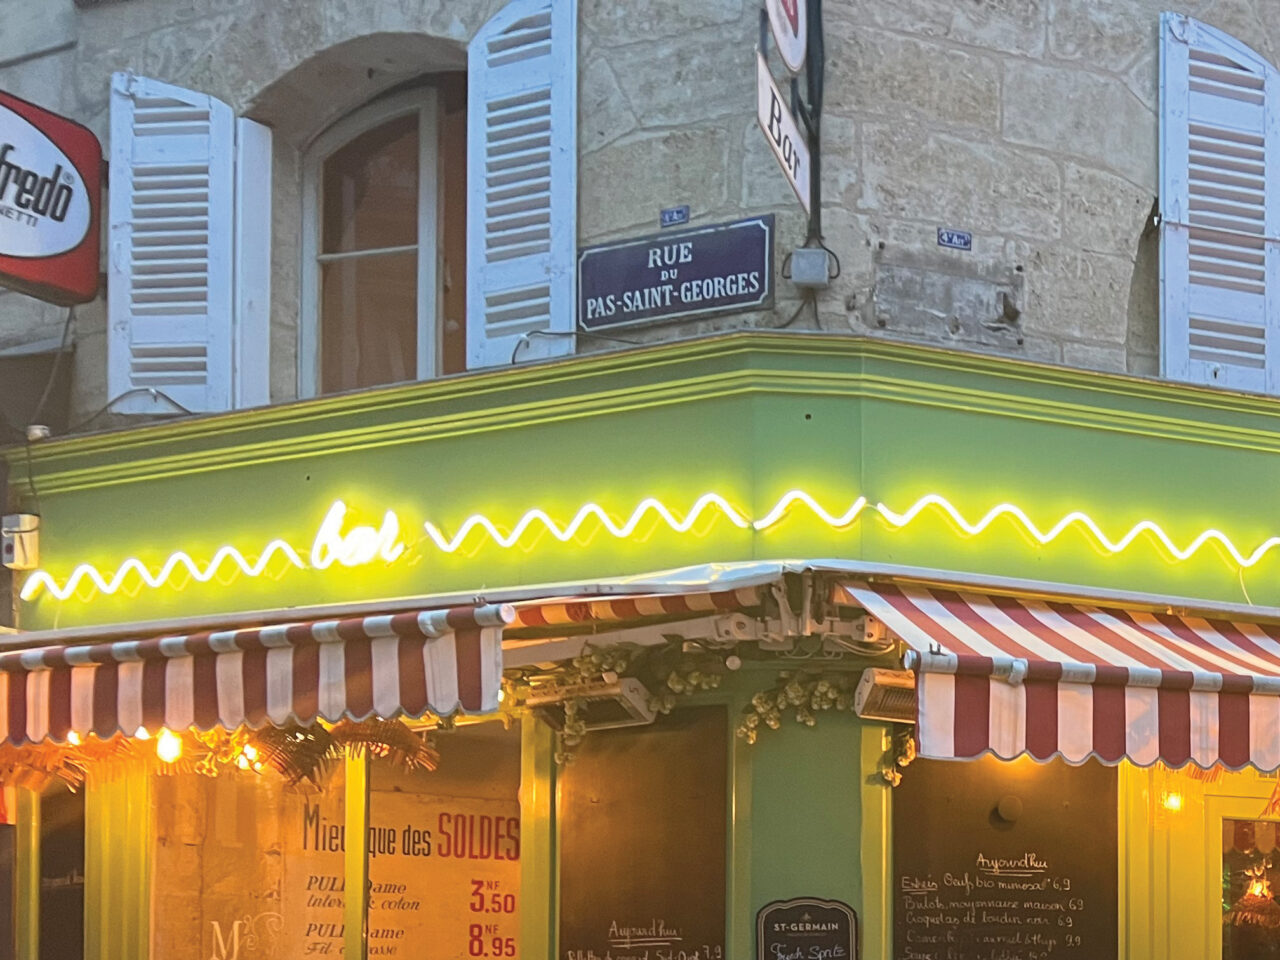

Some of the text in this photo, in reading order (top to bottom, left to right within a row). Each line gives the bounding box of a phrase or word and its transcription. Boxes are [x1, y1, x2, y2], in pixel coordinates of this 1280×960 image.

[766, 86, 801, 181] Bar
[648, 242, 693, 268] RUE
[660, 269, 678, 281] DU
[586, 271, 760, 320] PAS-SAINT-GEORGES
[401, 824, 431, 857] des
[437, 812, 520, 861] SOLDES
[486, 880, 501, 891] NF
[484, 924, 499, 935] NF
[773, 922, 839, 932] ST-GERMAIN
